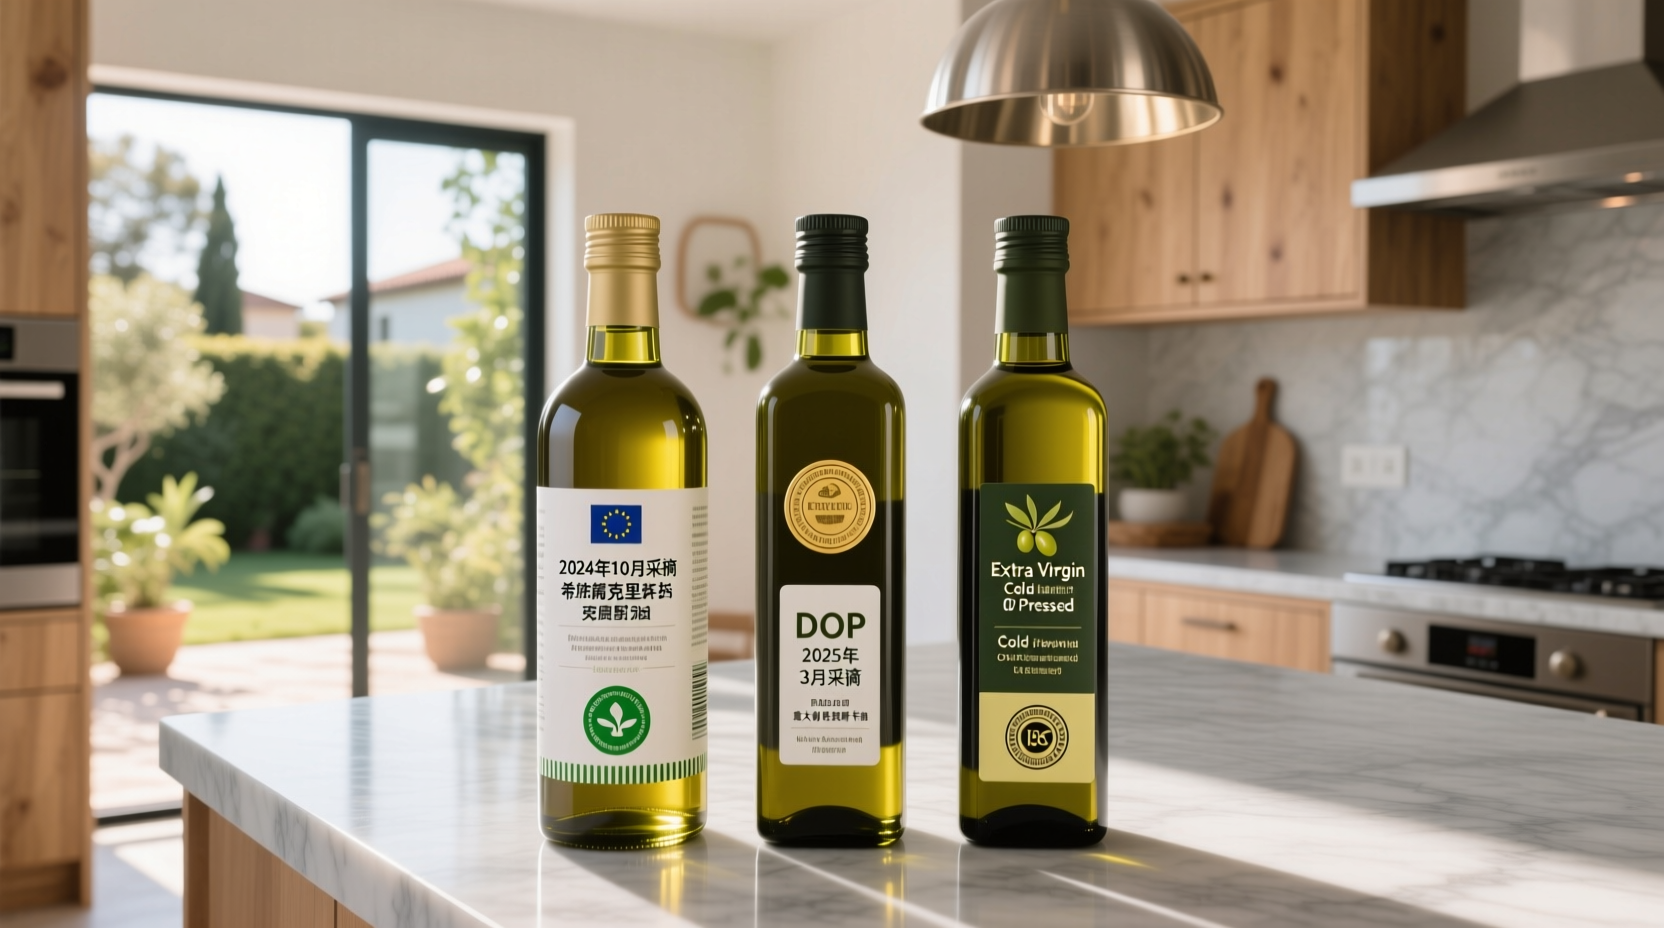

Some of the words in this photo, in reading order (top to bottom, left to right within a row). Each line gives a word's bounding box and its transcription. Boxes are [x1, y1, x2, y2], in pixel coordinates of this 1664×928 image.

[991, 561, 1033, 578] Extra
[1037, 561, 1085, 582] Virgin
[1003, 581, 1034, 595] Cold
[1018, 597, 1074, 612] Pressed
[796, 612, 866, 639] DOP
[997, 634, 1029, 649] Cold
[802, 646, 859, 664] 2025年
